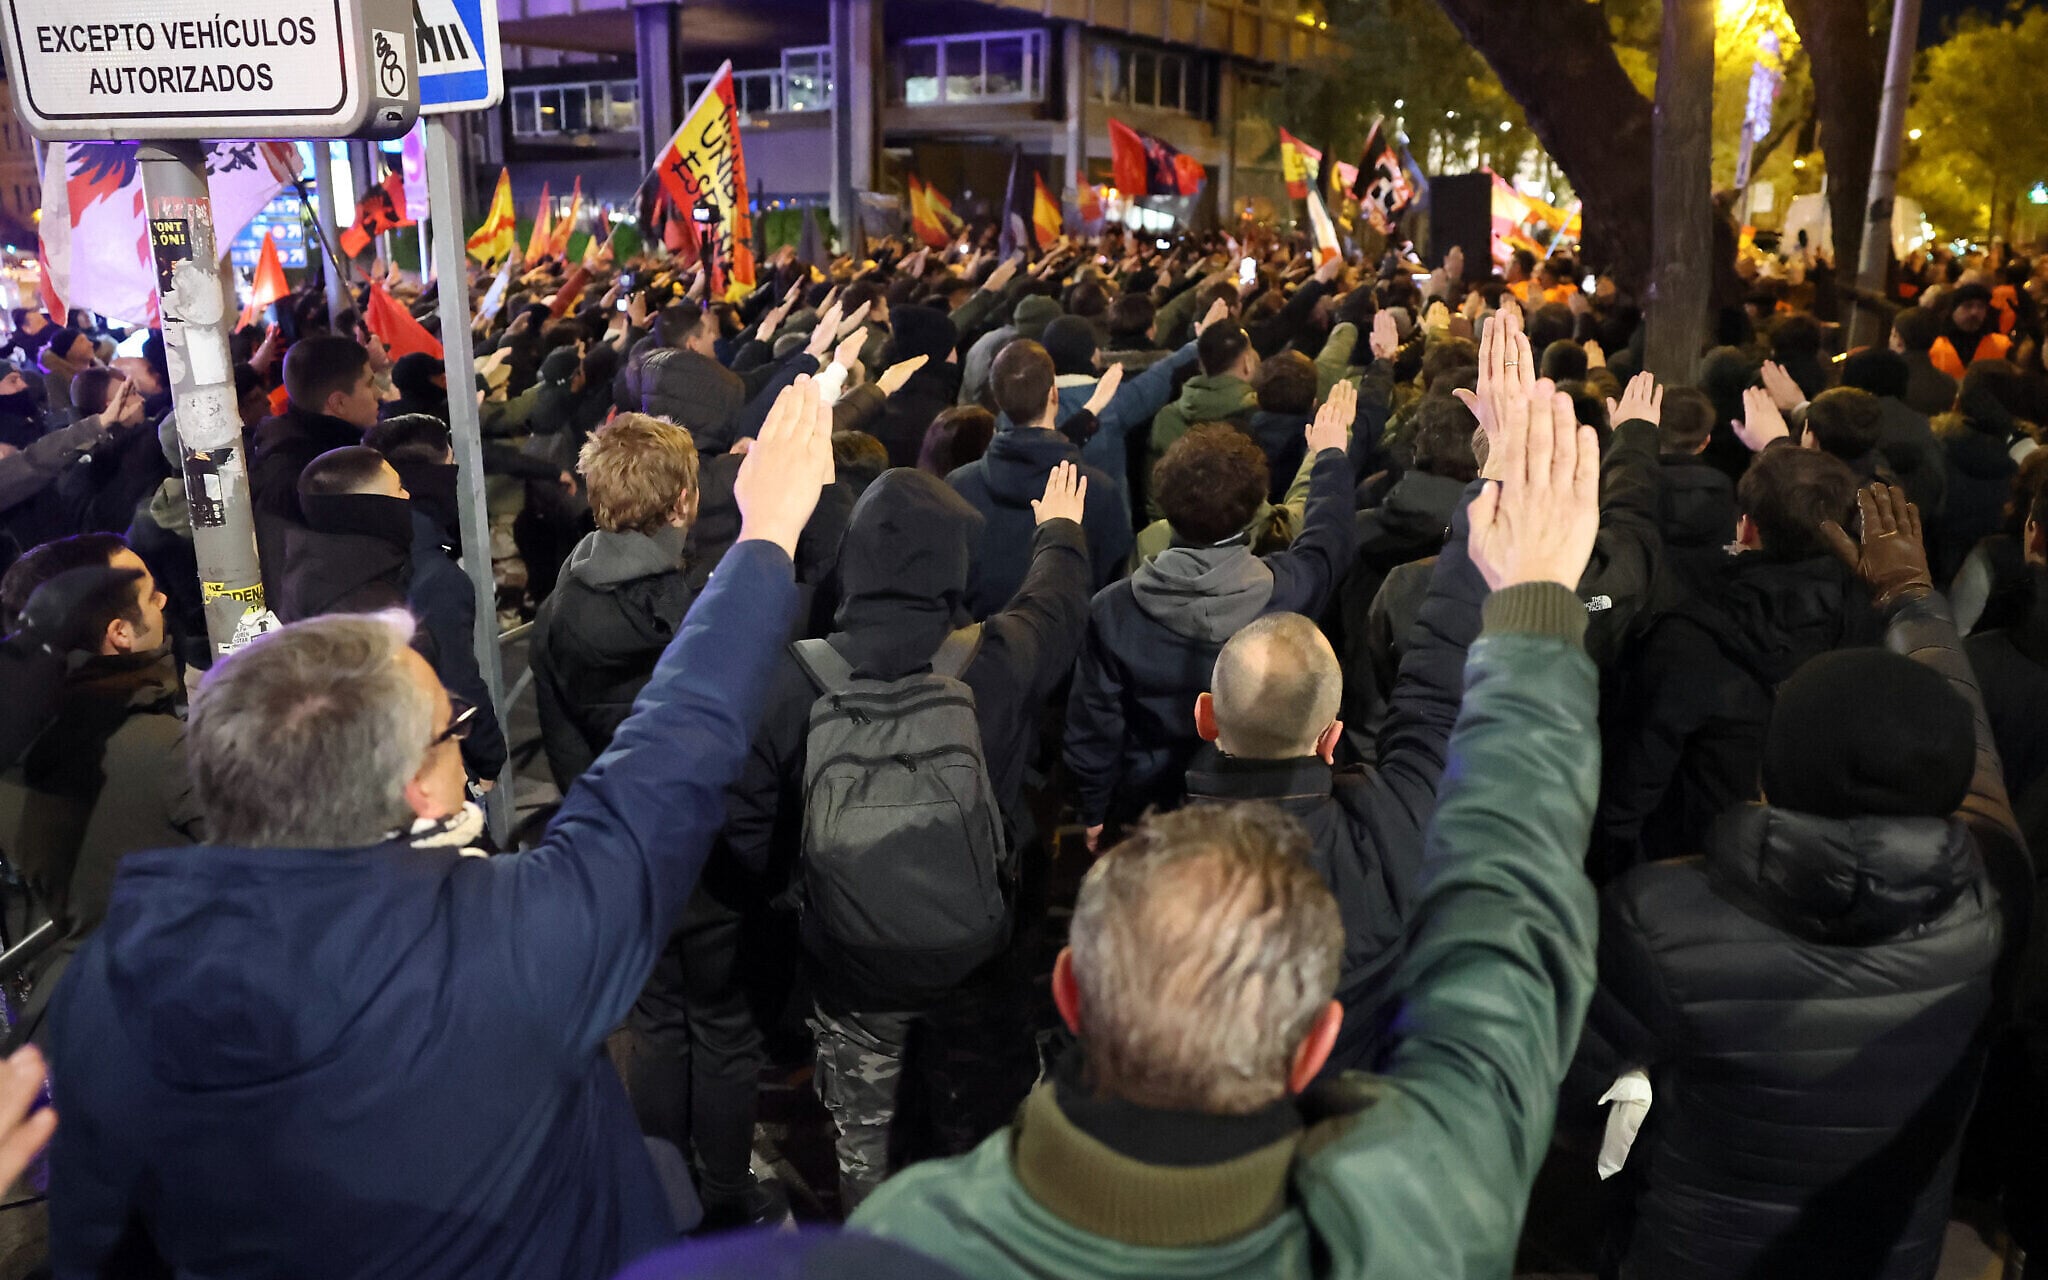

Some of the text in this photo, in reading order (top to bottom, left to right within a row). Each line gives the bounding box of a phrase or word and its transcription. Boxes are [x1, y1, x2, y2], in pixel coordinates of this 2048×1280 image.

[36, 13, 317, 53] EXCEPTO VEHÍCULOS
[89, 63, 274, 95] AUTORIZADOS
[153, 221, 183, 232] ONT
